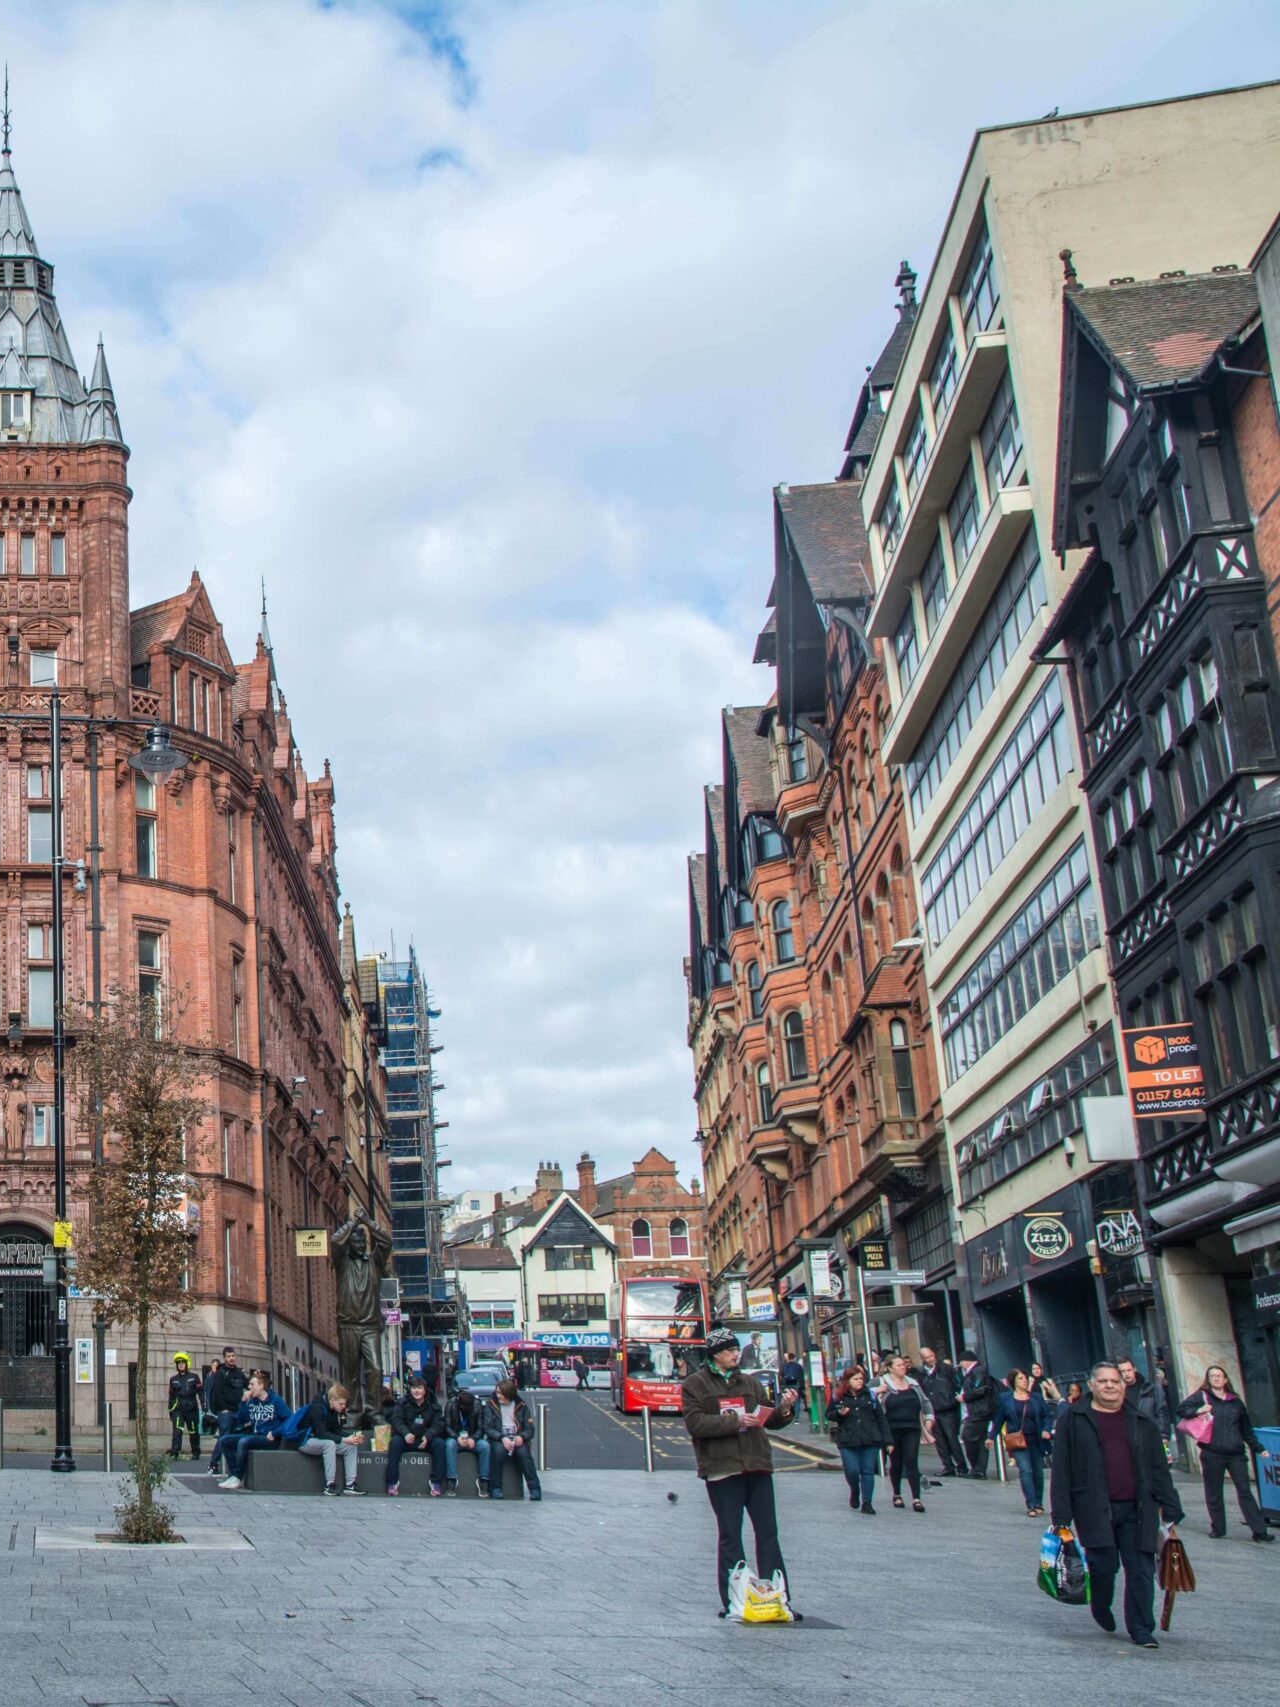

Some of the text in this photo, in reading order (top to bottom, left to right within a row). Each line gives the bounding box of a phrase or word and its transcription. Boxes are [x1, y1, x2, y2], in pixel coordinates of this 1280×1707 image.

[1167, 1036, 1190, 1045] BOX
[1152, 1069, 1199, 1082] TO LET
[1136, 1089, 1170, 1102] 01157
[1030, 1232, 1063, 1243] Zizzi
[574, 1334, 608, 1345] Vape
[410, 1456, 430, 1465] OBE
